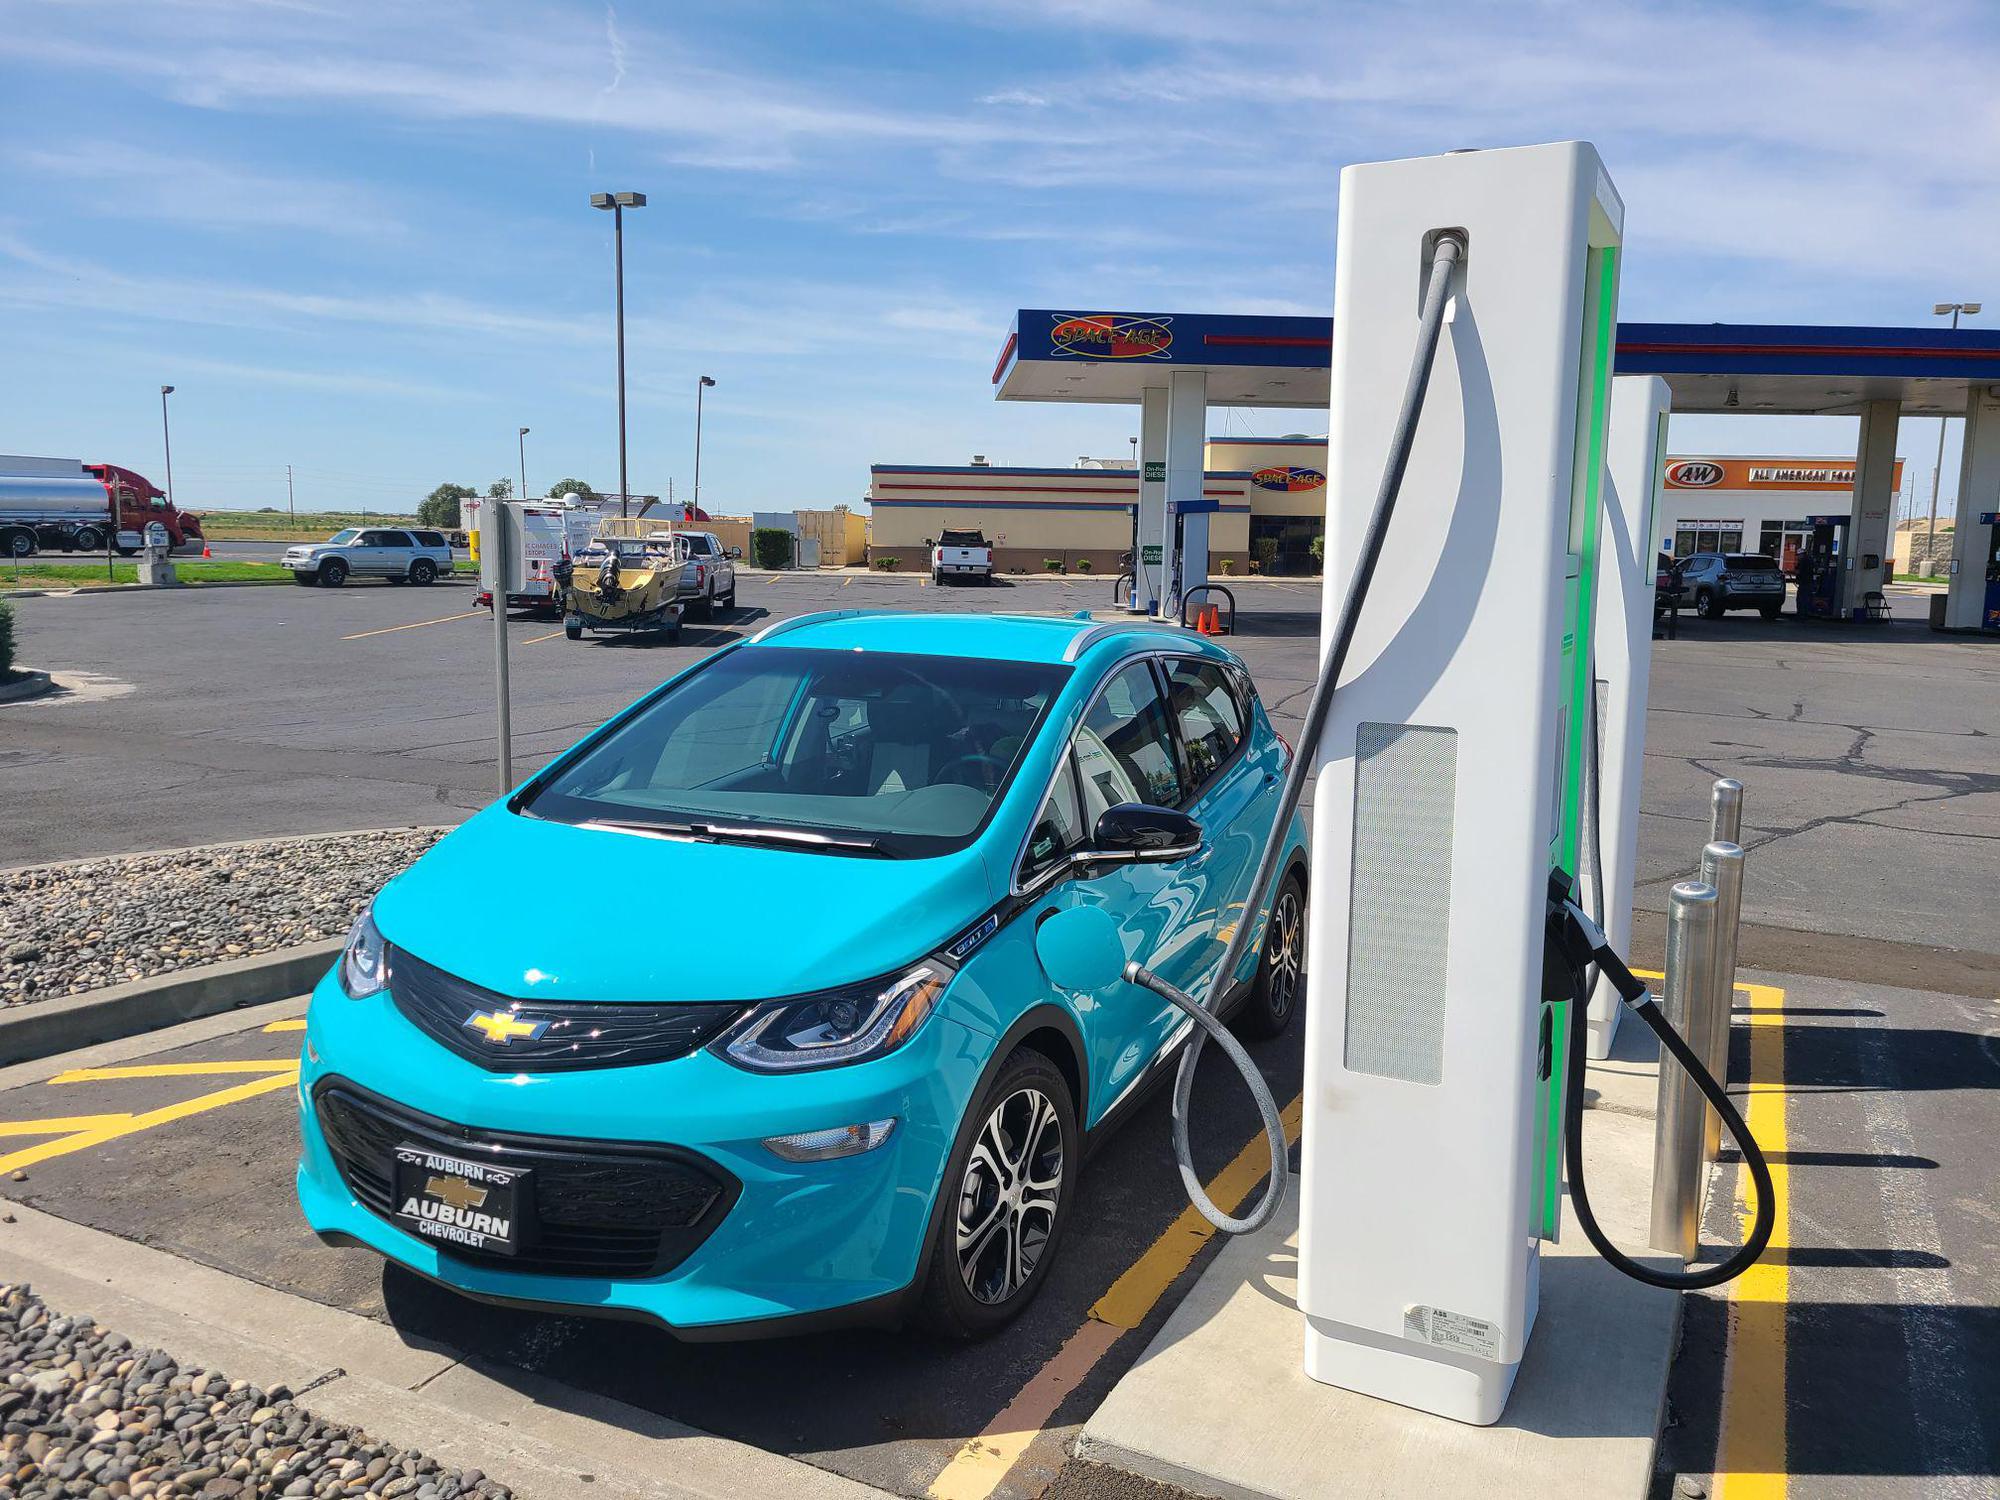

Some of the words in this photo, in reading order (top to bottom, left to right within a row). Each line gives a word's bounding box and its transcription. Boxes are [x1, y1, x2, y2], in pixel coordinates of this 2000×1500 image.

[1059, 326, 1117, 344] SPACE
[1123, 328, 1162, 345] AGE
[1254, 473, 1293, 484] SPACE
[1296, 474, 1321, 484] AGE
[1751, 470, 1769, 480] ALL
[1773, 470, 1826, 481] AMERICAN
[425, 1155, 484, 1181] AUBURN
[401, 1197, 510, 1238] AUBURN
[418, 1220, 485, 1248] CHEVROLET
